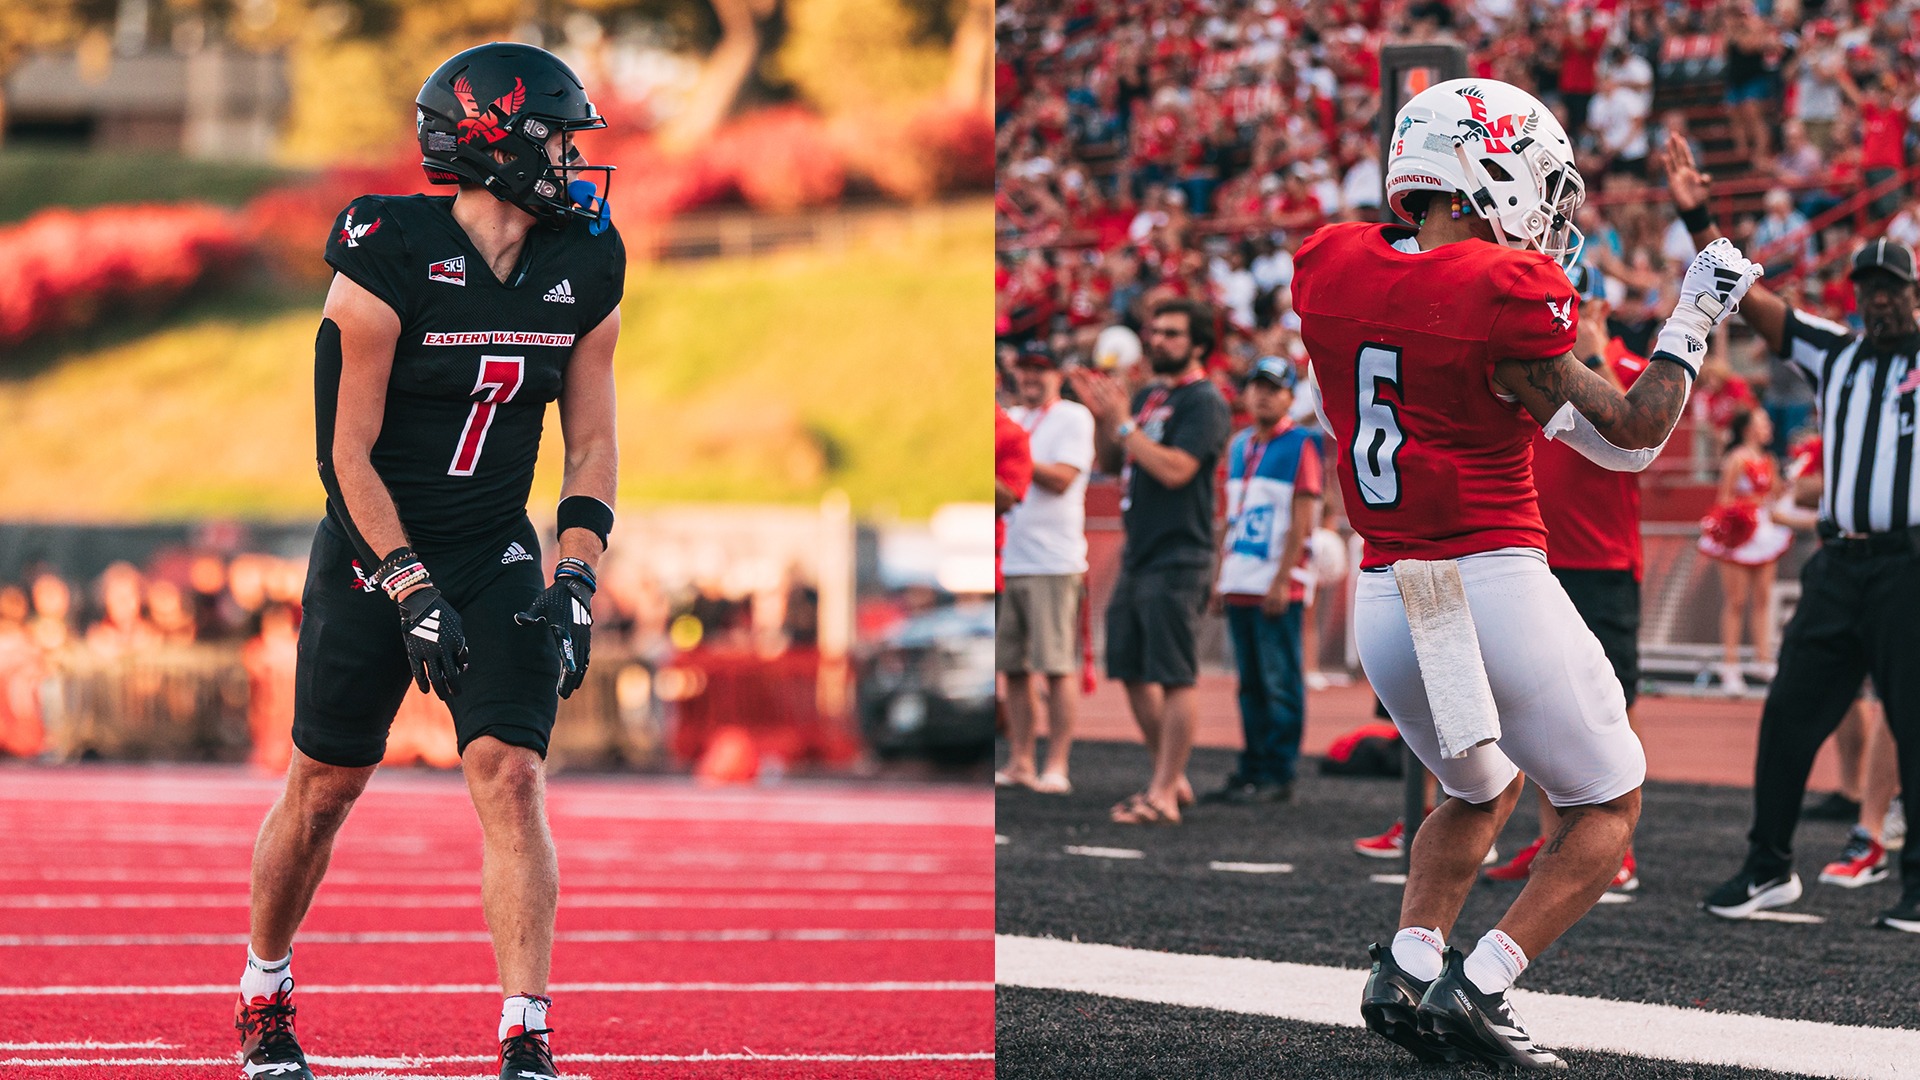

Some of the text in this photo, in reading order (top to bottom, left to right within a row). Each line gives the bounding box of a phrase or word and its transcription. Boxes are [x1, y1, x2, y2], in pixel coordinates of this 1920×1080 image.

[1396, 139, 1404, 156] 6
[543, 293, 575, 304] adidas
[423, 331, 574, 346] EASTERN WASHINGTON
[1685, 334, 1703, 349] adidas
[448, 356, 525, 476] 7
[1350, 341, 1408, 510] 6
[501, 553, 533, 565] adidas
